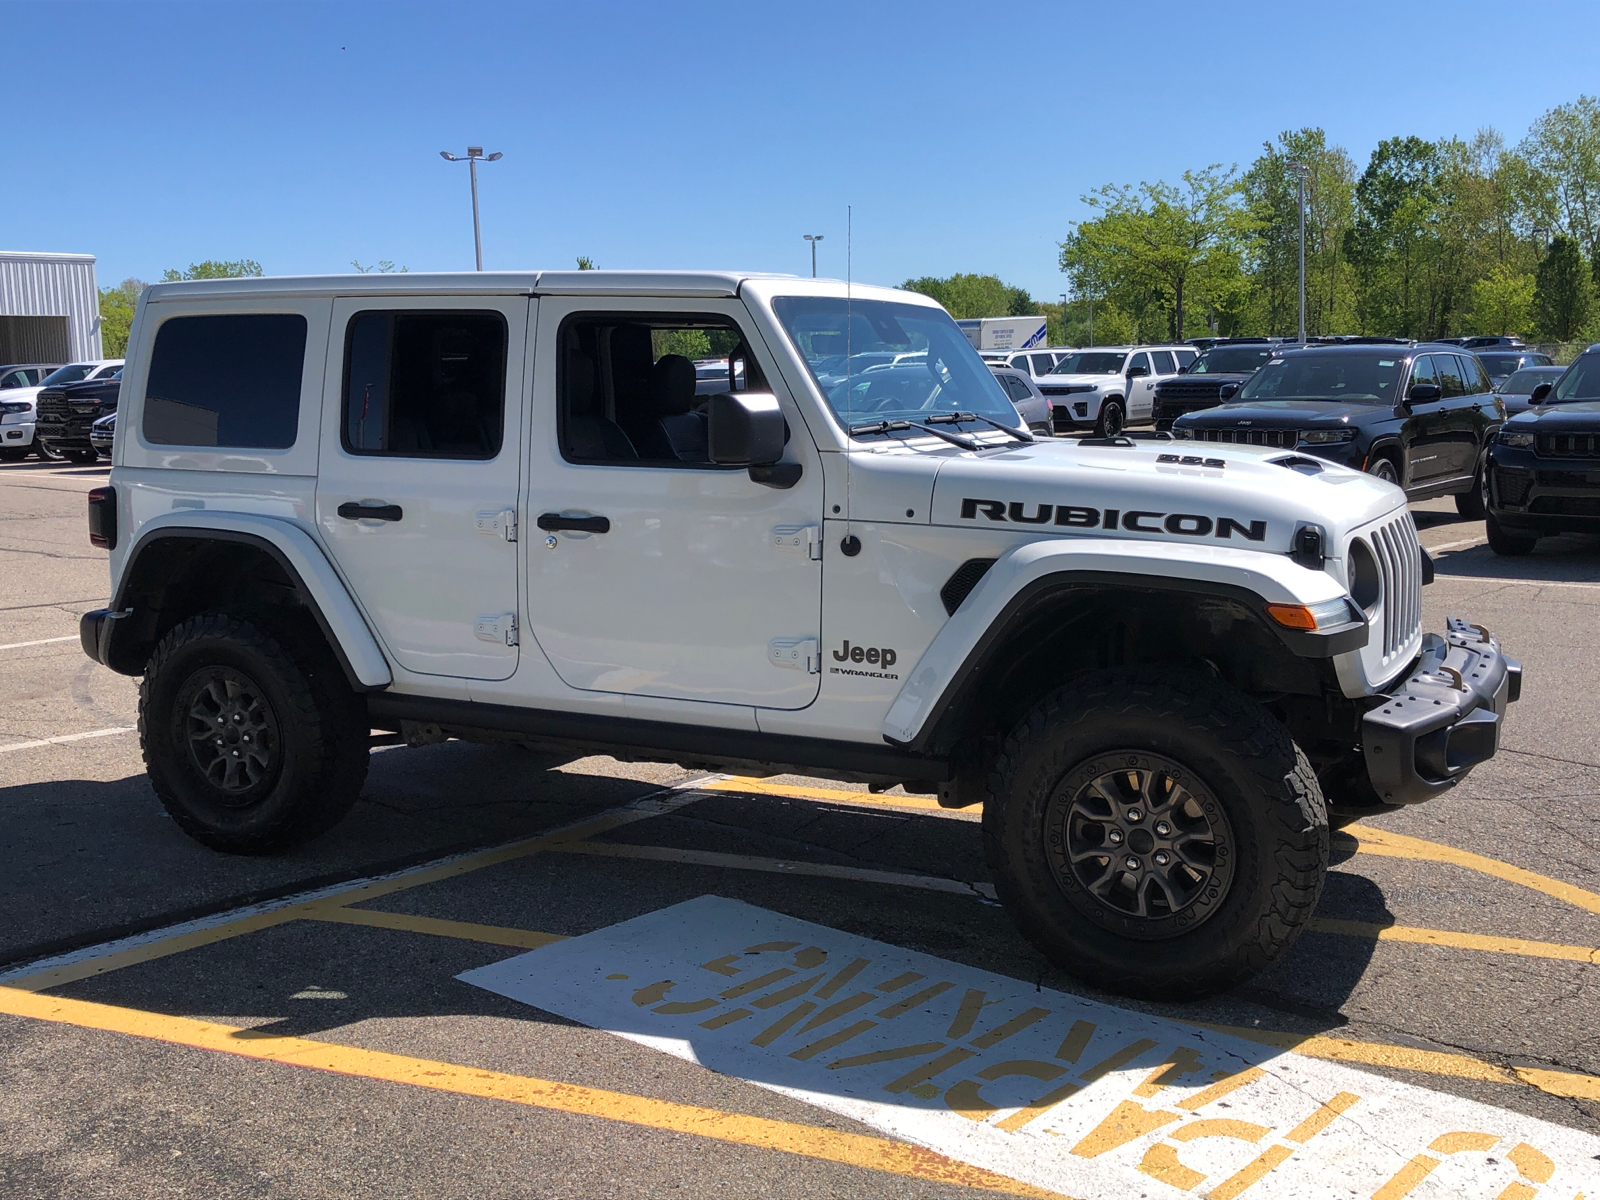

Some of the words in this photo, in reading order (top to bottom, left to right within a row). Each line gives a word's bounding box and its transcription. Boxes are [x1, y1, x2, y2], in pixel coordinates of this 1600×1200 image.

[960, 498, 1267, 542] RUBICON
[833, 640, 897, 670] Jeep
[840, 668, 899, 680] WRANGLER
[631, 941, 1361, 1200] PARKING
